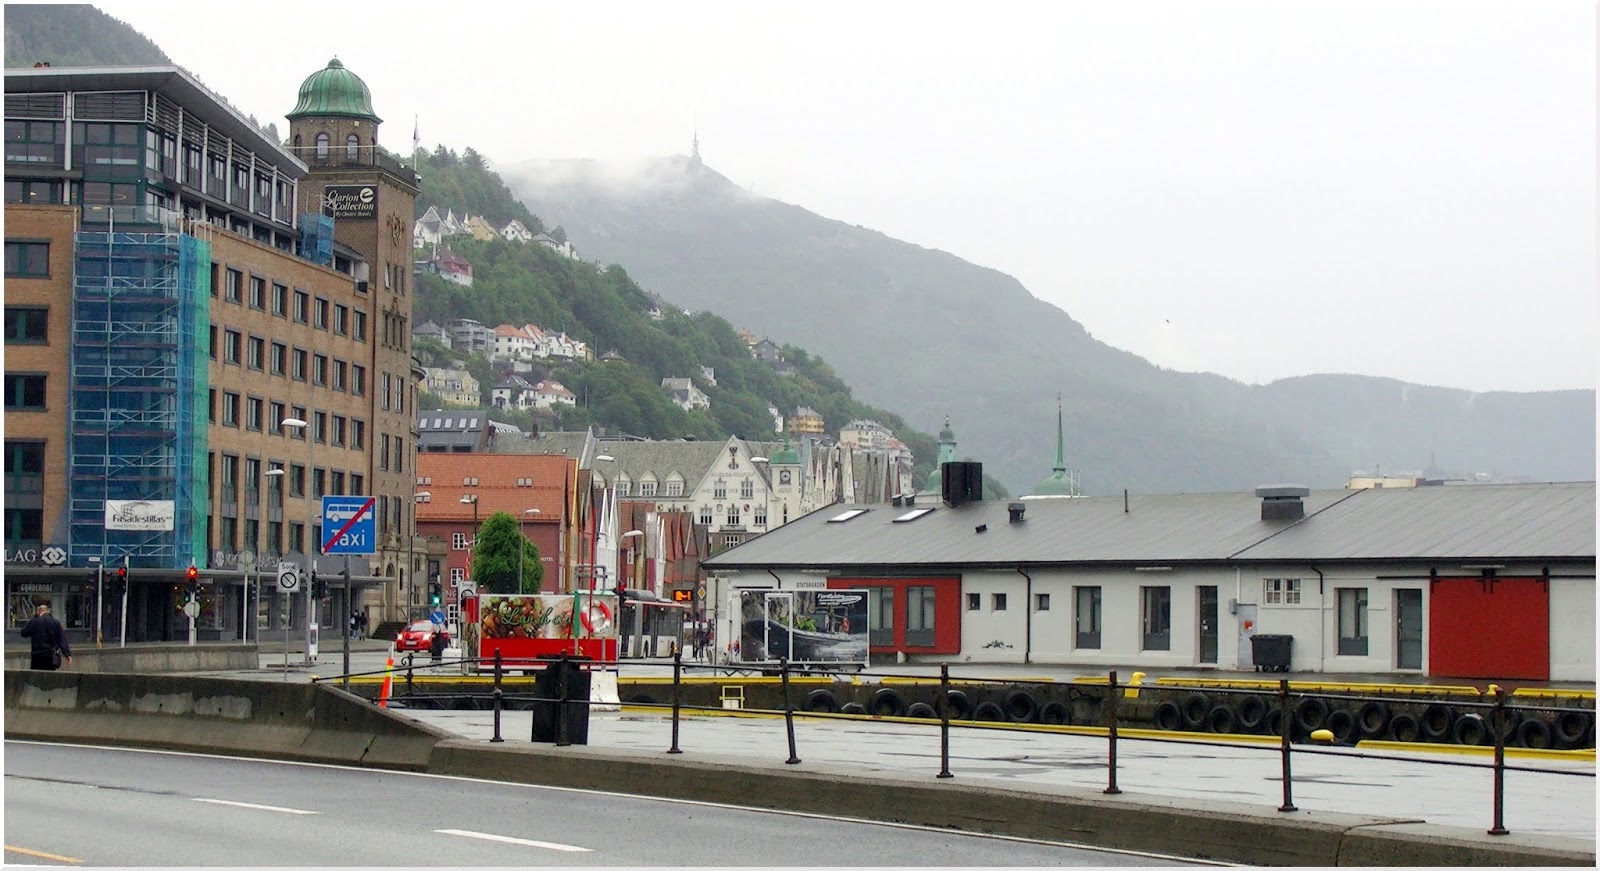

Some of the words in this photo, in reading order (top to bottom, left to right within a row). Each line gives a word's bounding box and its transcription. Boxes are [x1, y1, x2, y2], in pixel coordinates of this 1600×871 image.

[328, 190, 359, 202] Clarion
[335, 202, 375, 211] Collection
[112, 514, 166, 523] Fasadestillas
[331, 529, 365, 546] Taxi
